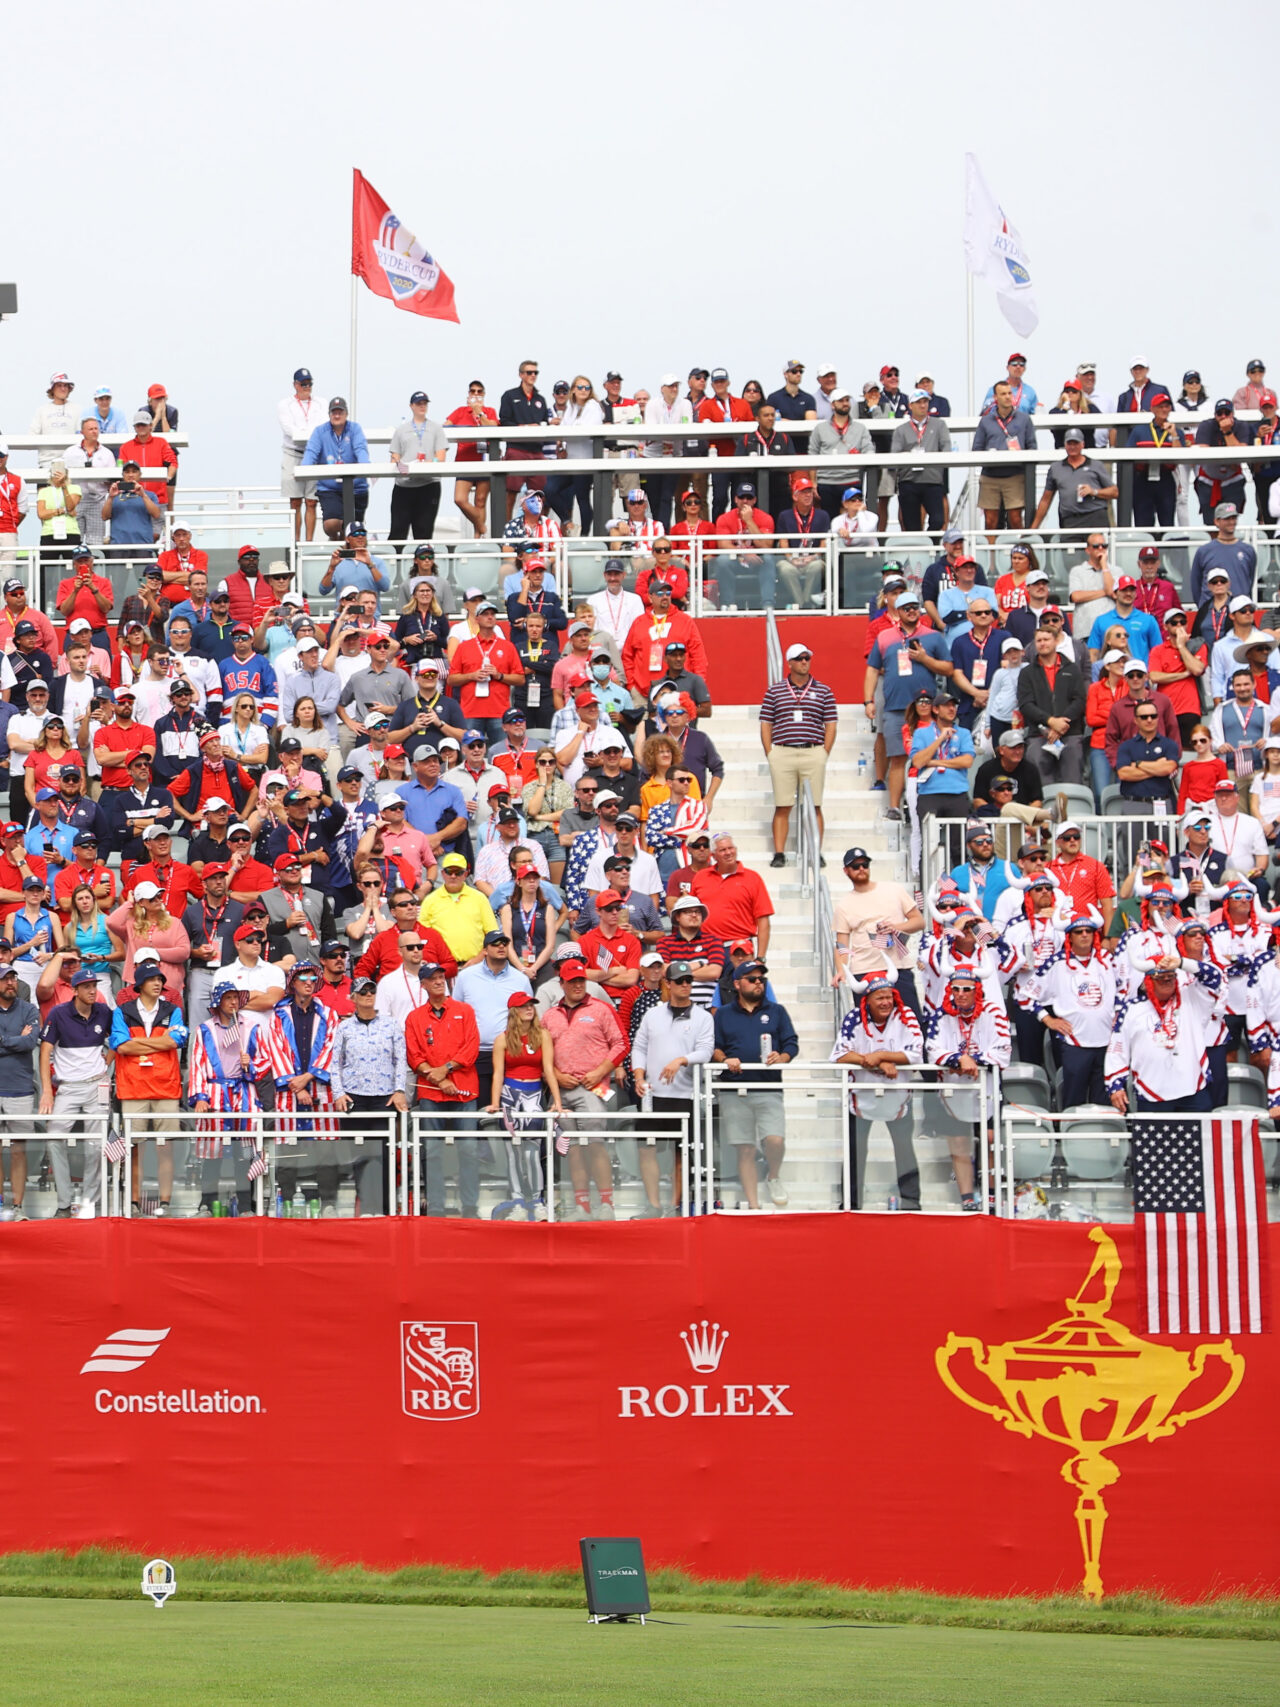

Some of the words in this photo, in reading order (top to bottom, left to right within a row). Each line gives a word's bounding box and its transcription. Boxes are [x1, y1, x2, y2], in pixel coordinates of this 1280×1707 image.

[378, 250, 412, 273] RYDER
[411, 264, 436, 281] CUP
[1002, 594, 1027, 609] USA
[225, 667, 261, 693] USA
[95, 1388, 261, 1413] Constellation
[411, 1389, 472, 1411] RBC
[618, 1384, 794, 1418] ROLEX
